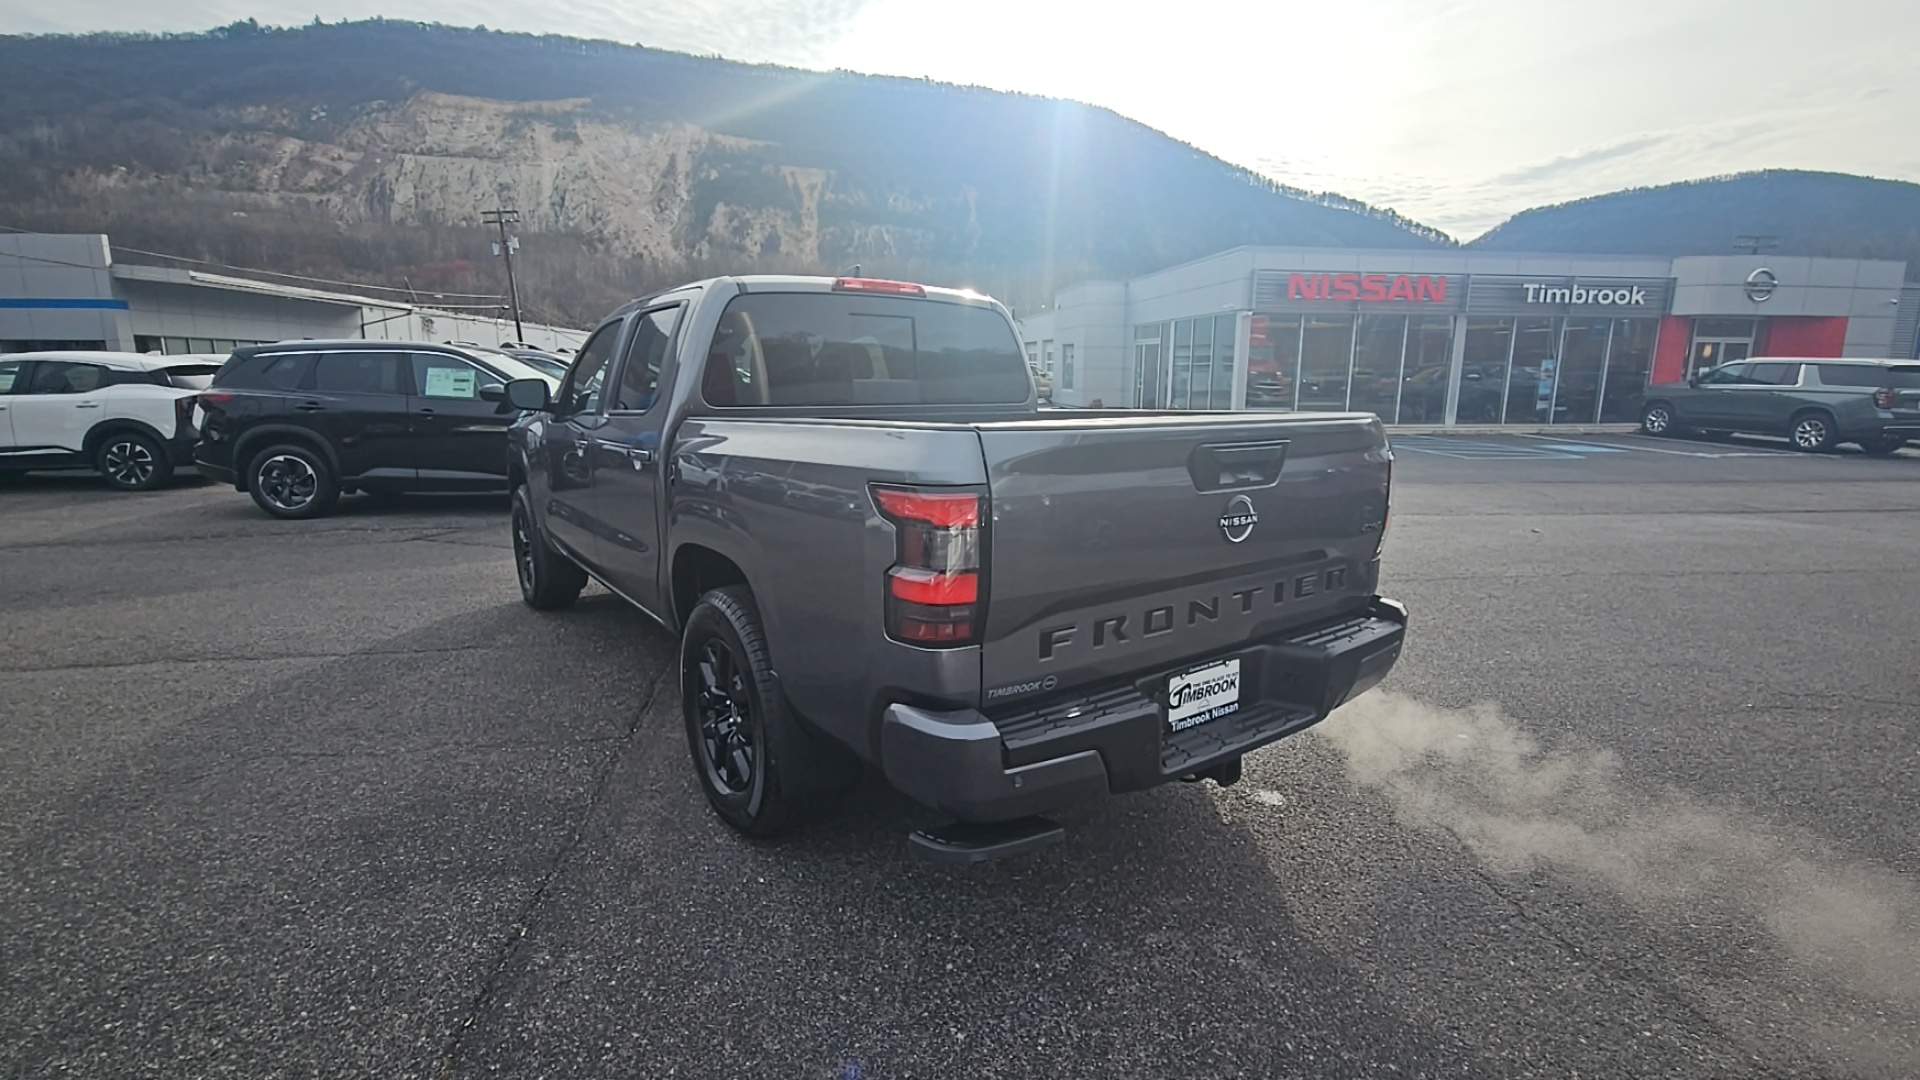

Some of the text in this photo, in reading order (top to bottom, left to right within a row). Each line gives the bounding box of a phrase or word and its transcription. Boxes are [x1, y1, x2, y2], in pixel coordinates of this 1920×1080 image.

[1287, 273, 1448, 303] NISSAN
[1522, 283, 1646, 305] Timbrook
[1220, 515, 1258, 527] NISSAN
[1038, 565, 1347, 662] FRONTIER
[987, 680, 1042, 699] TIMBROOK
[1169, 677, 1238, 710] TIMBROOK
[1171, 702, 1239, 732] Timbrook Nissan
